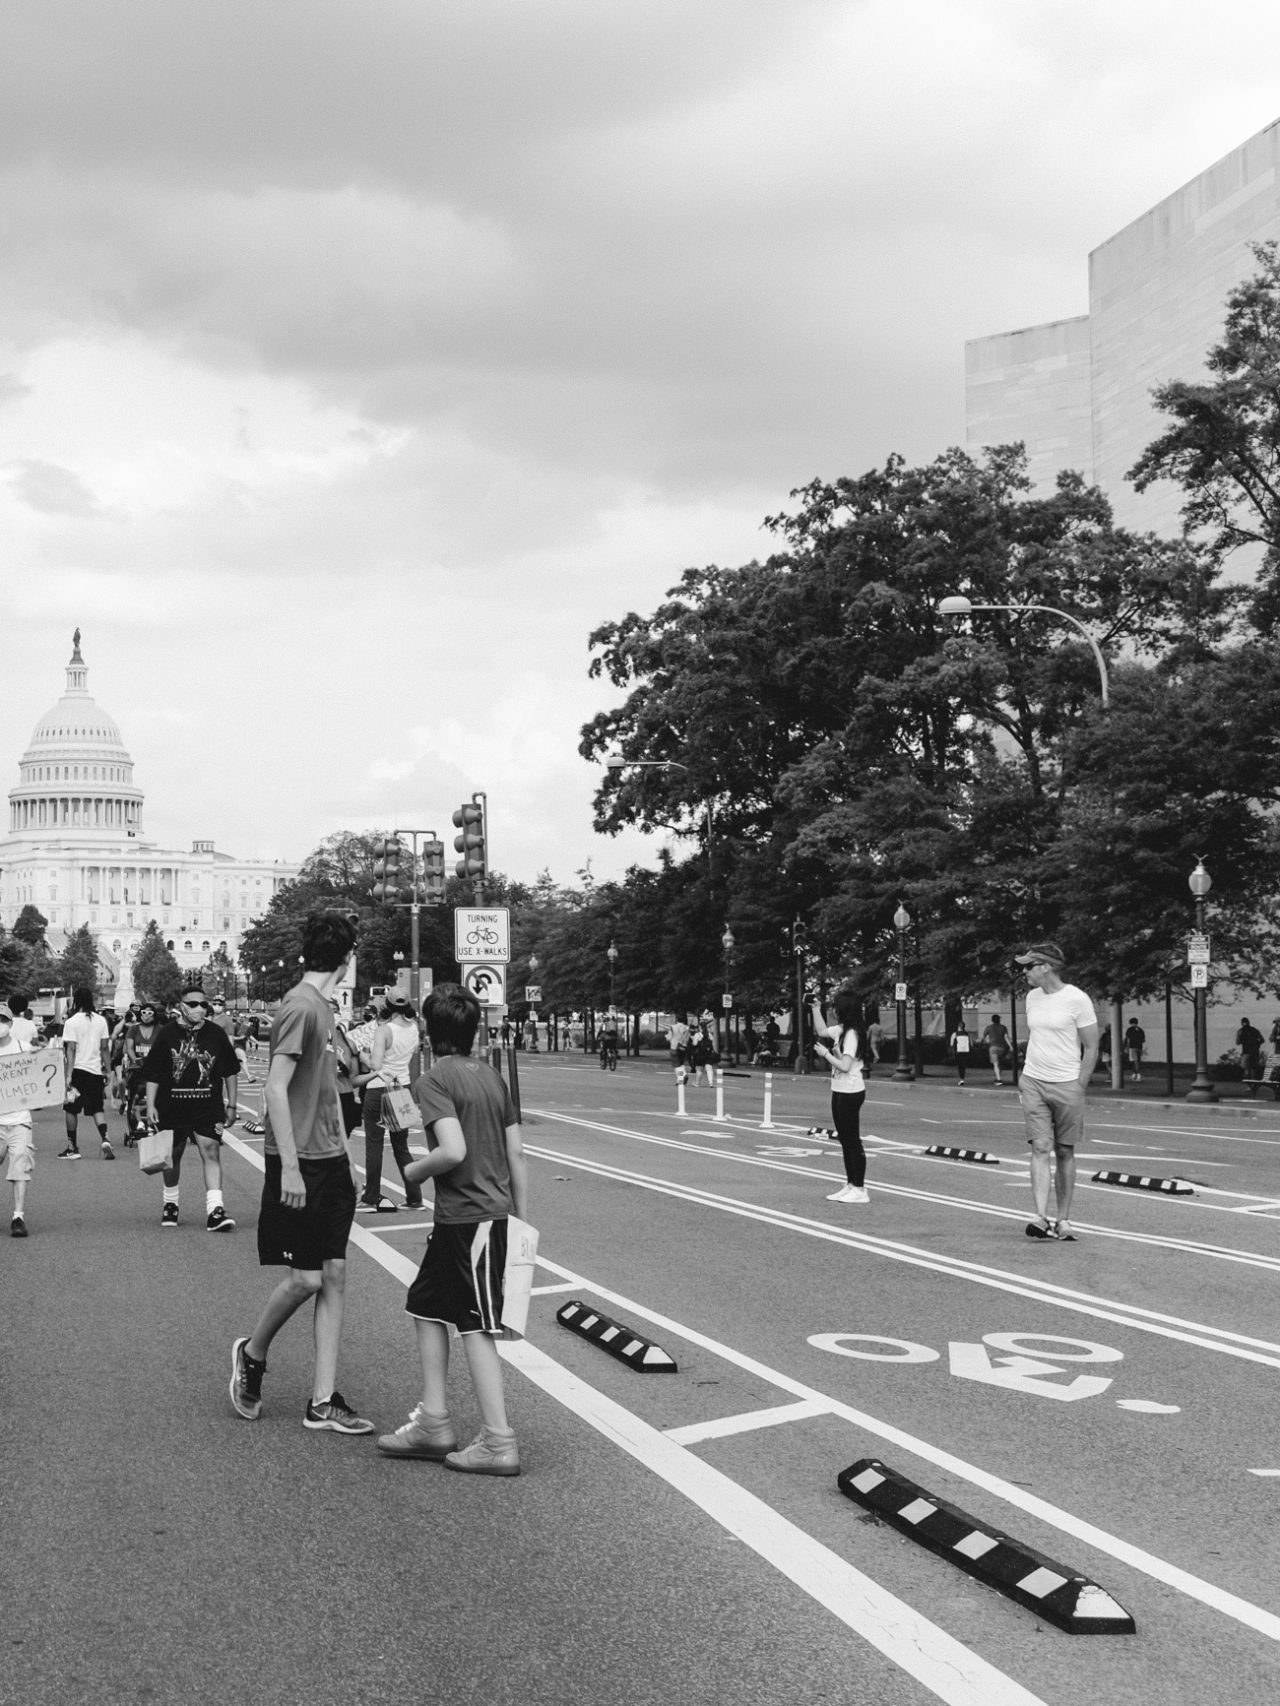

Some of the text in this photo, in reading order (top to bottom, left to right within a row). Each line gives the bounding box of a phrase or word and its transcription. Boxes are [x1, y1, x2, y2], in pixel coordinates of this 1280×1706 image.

[467, 914, 498, 923] TURNING
[458, 947, 507, 956] USE X-WALKS
[14, 1057, 38, 1067] MANY
